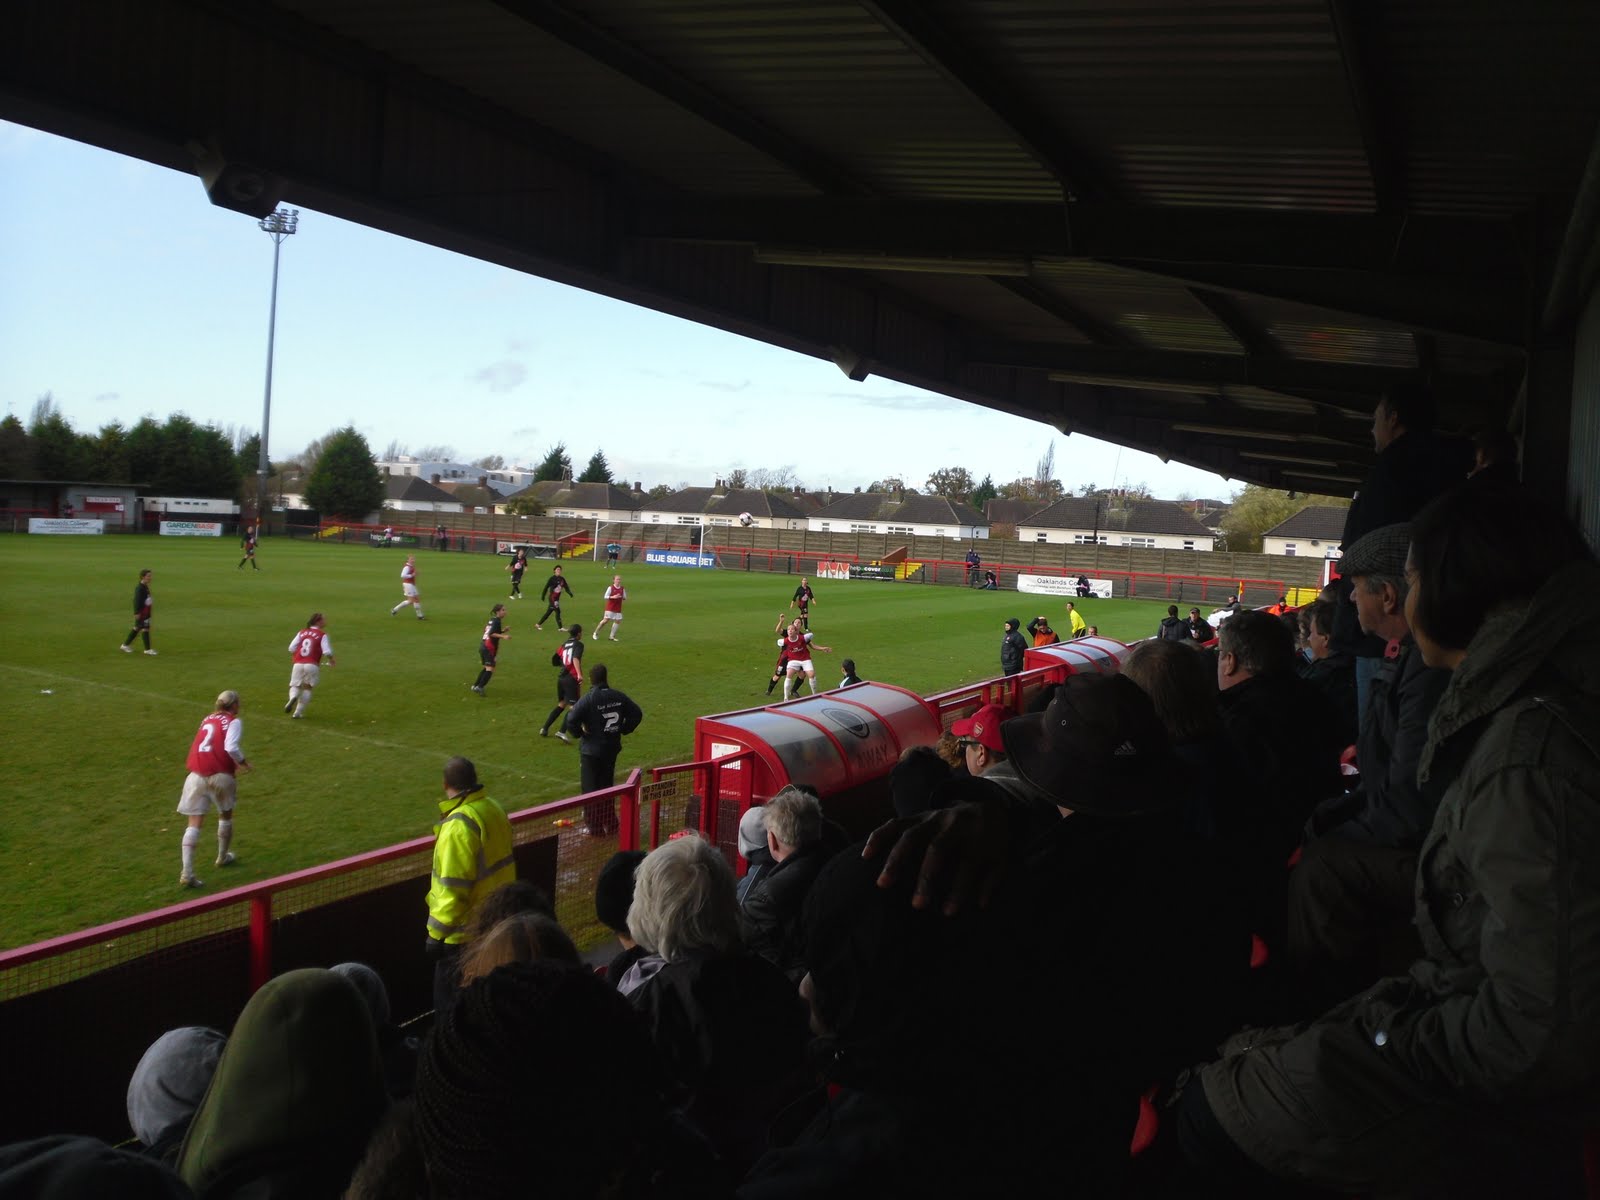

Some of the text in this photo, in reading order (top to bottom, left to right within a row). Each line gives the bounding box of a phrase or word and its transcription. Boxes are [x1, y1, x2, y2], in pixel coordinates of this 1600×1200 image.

[646, 553, 714, 566] BLUE SQUARE BET
[1037, 577, 1067, 586] Oaklands
[300, 638, 312, 657] 8
[562, 648, 573, 666] 11
[198, 723, 214, 752] 2
[856, 744, 889, 769] AWAY
[651, 779, 677, 792] STANDING
[650, 791, 661, 800] THIS
[662, 787, 676, 797] AREA
